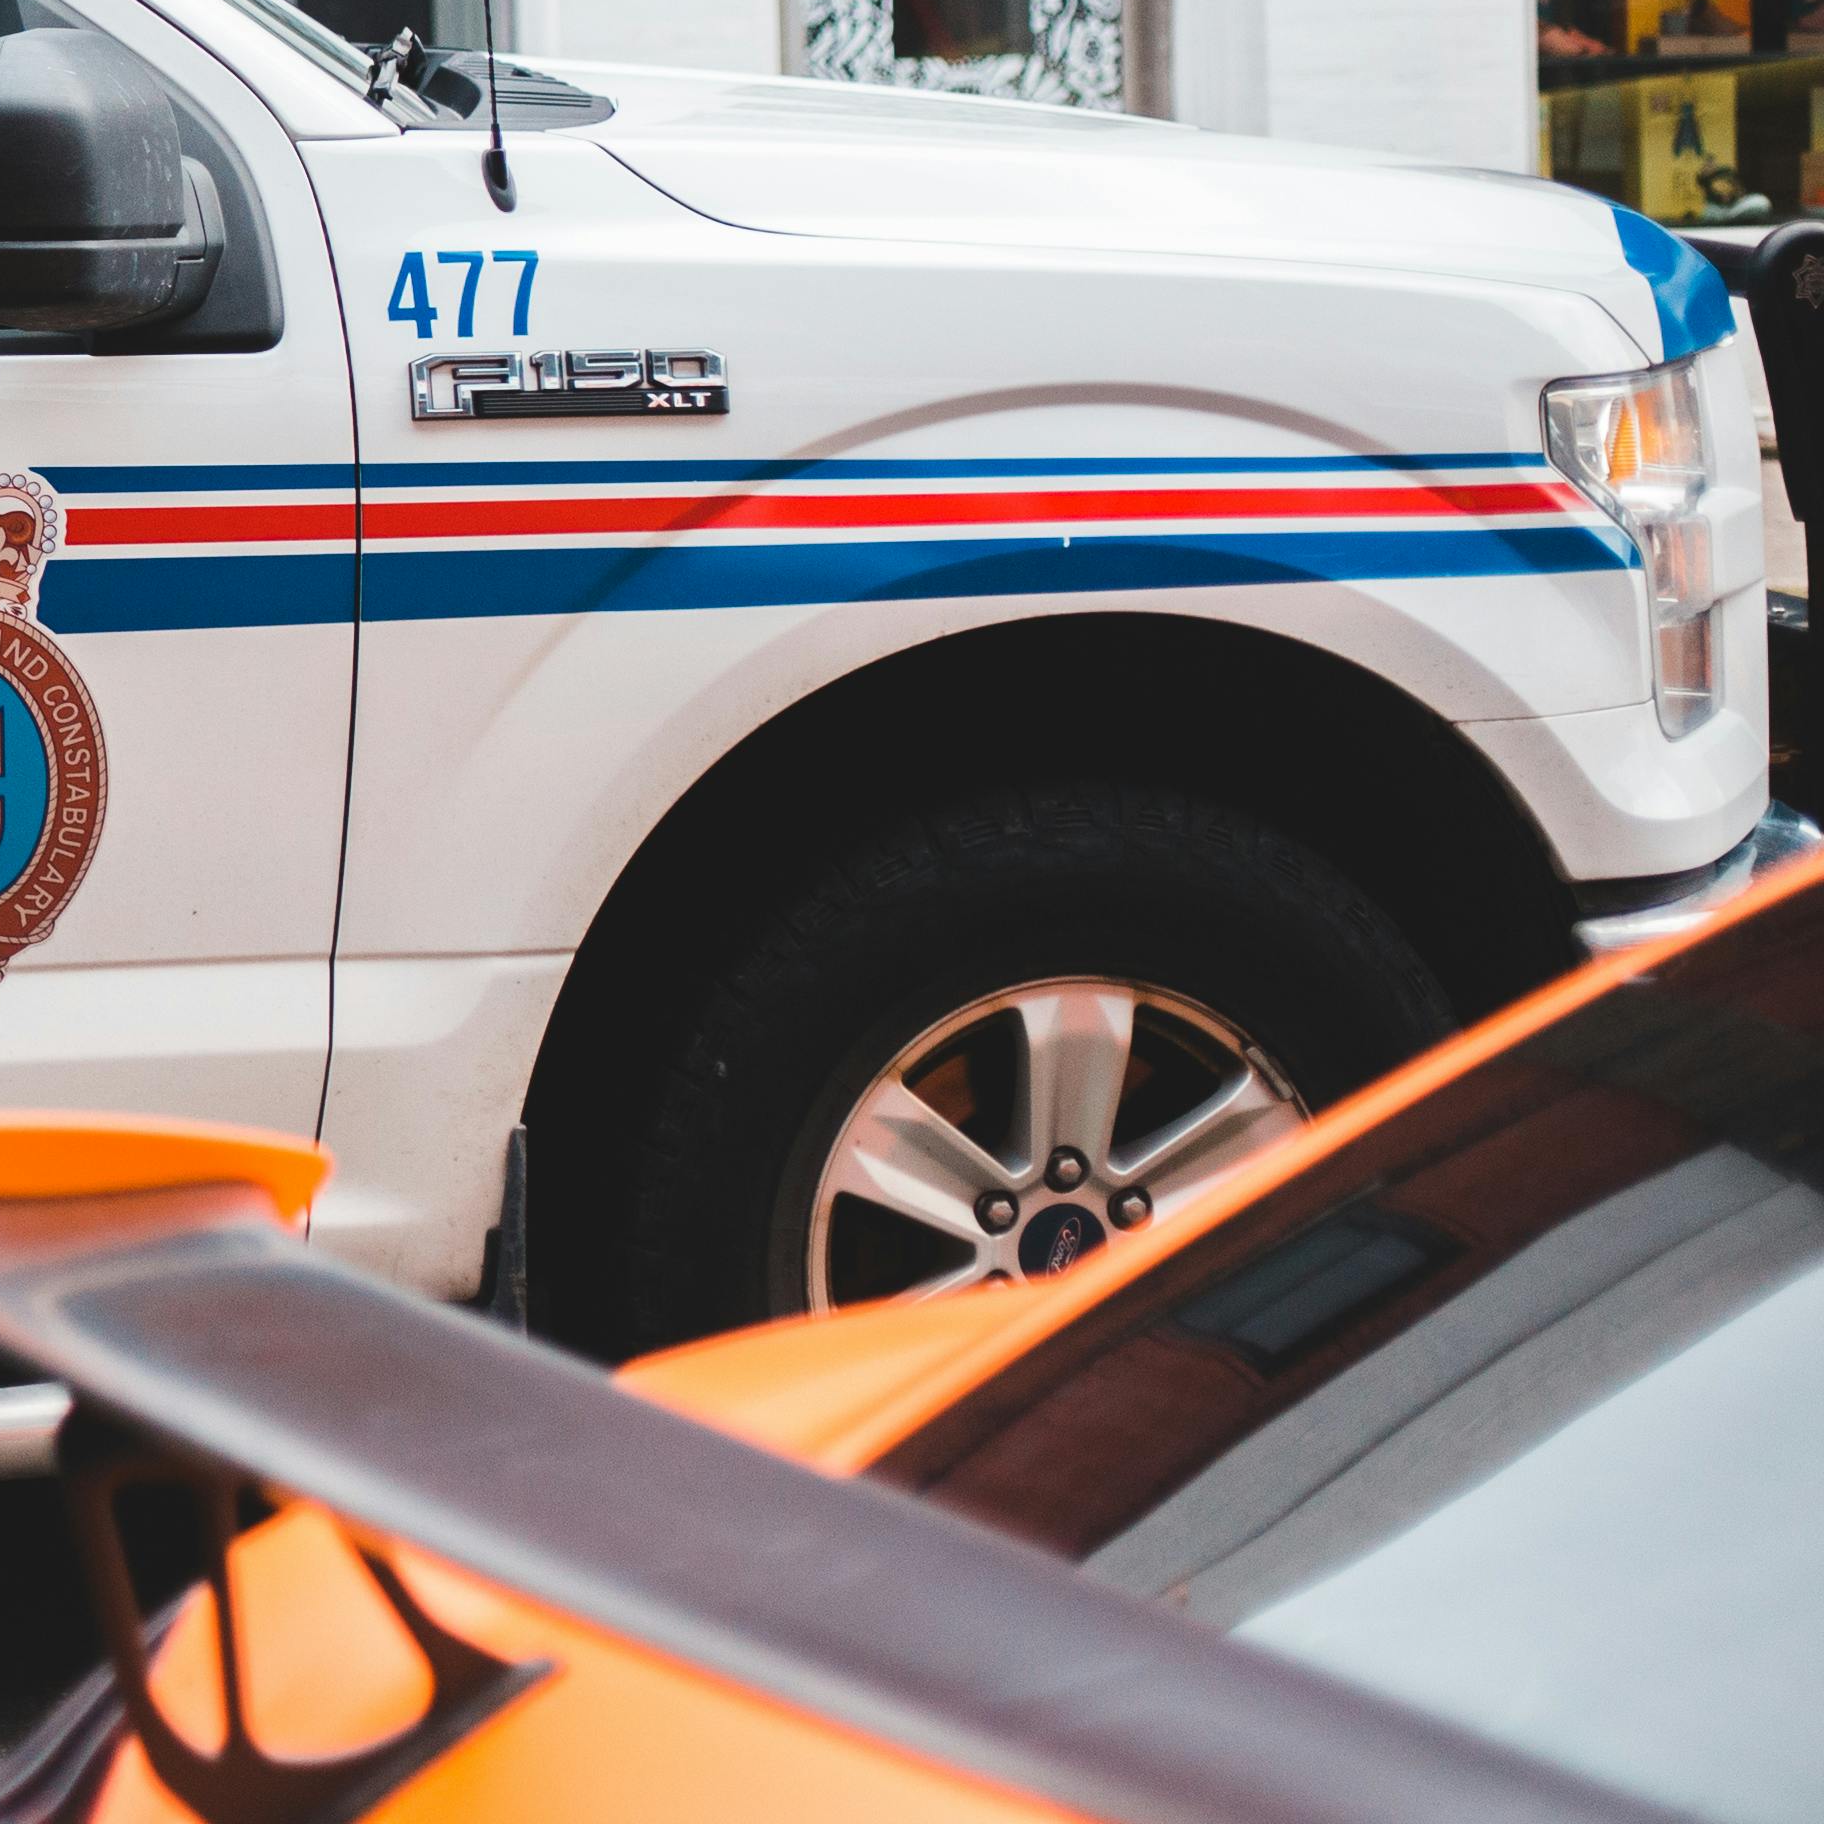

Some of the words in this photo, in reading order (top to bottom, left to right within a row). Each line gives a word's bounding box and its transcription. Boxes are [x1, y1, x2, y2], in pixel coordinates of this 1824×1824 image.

[387, 249, 540, 339] 477
[646, 391, 712, 408] XLT
[12, 683, 93, 929] CONSTABULARY
